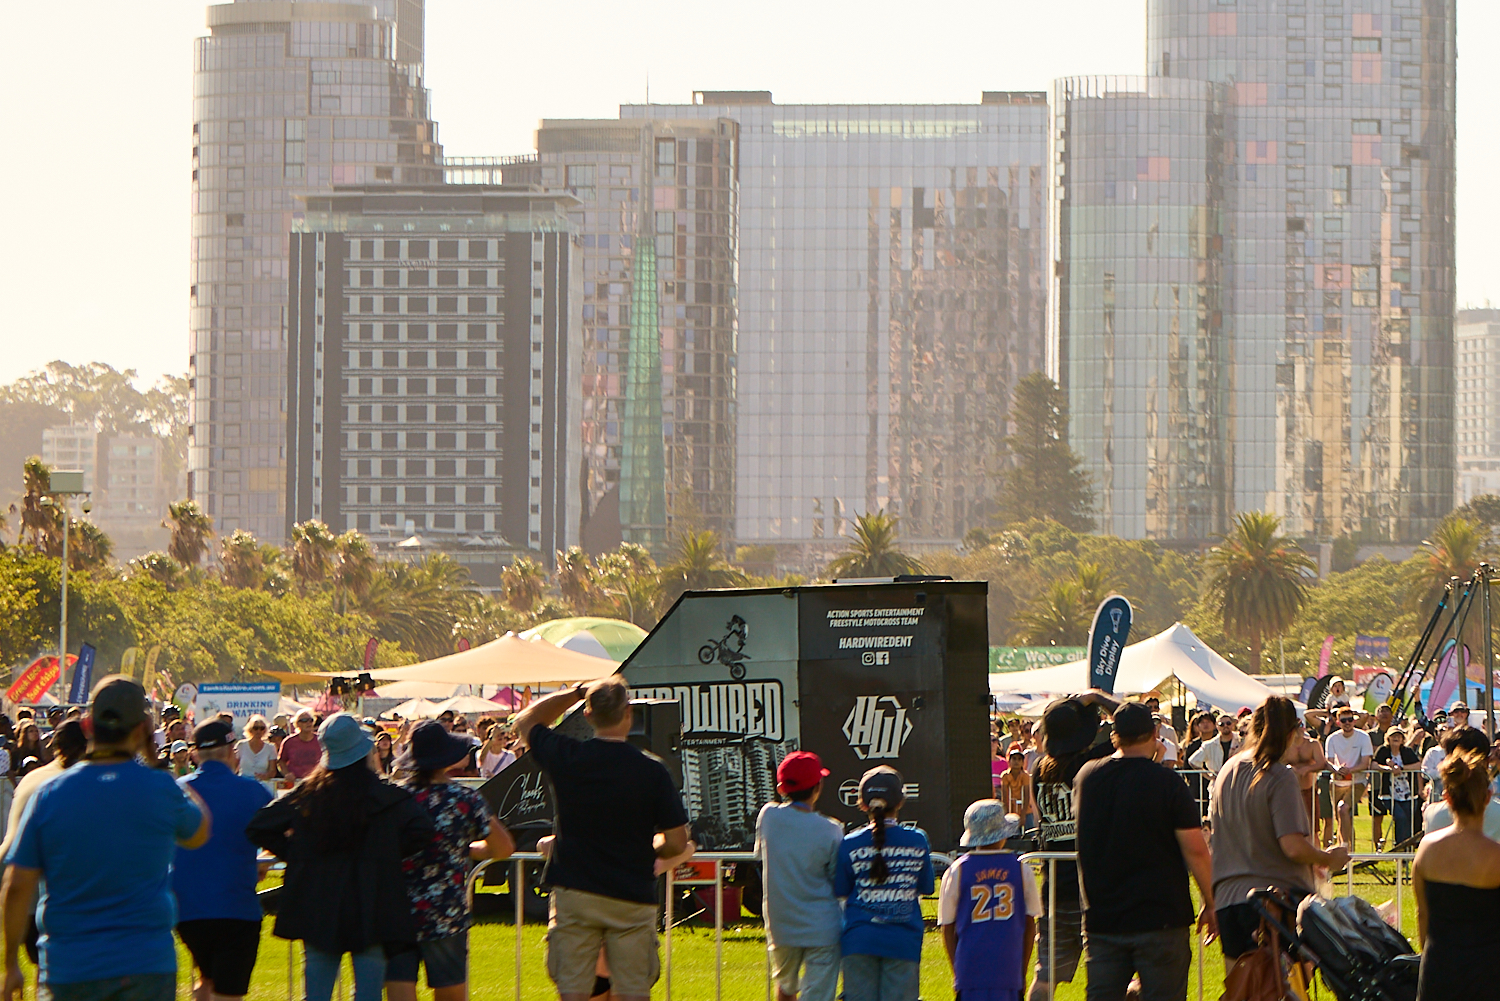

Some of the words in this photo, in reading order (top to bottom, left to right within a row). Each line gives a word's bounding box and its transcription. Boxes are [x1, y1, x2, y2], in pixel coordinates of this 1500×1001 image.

[826, 610, 850, 618] ACTION
[850, 608, 874, 618] SPORTS
[874, 607, 925, 617] ENTERTAINMENT
[829, 618, 863, 627] FREESTYLE
[863, 617, 900, 626] MOTOCROSS
[900, 617, 919, 626] TEAM
[839, 635, 914, 649] HARDWIREDENT
[1100, 635, 1111, 658] Dive
[1105, 639, 1120, 676] Display
[1095, 656, 1108, 677] Sky
[226, 700, 273, 709] DRINKING
[628, 682, 783, 741] DWIRED
[232, 708, 267, 718] WATER
[975, 868, 1010, 883] JAMES
[970, 882, 1015, 924] 23
